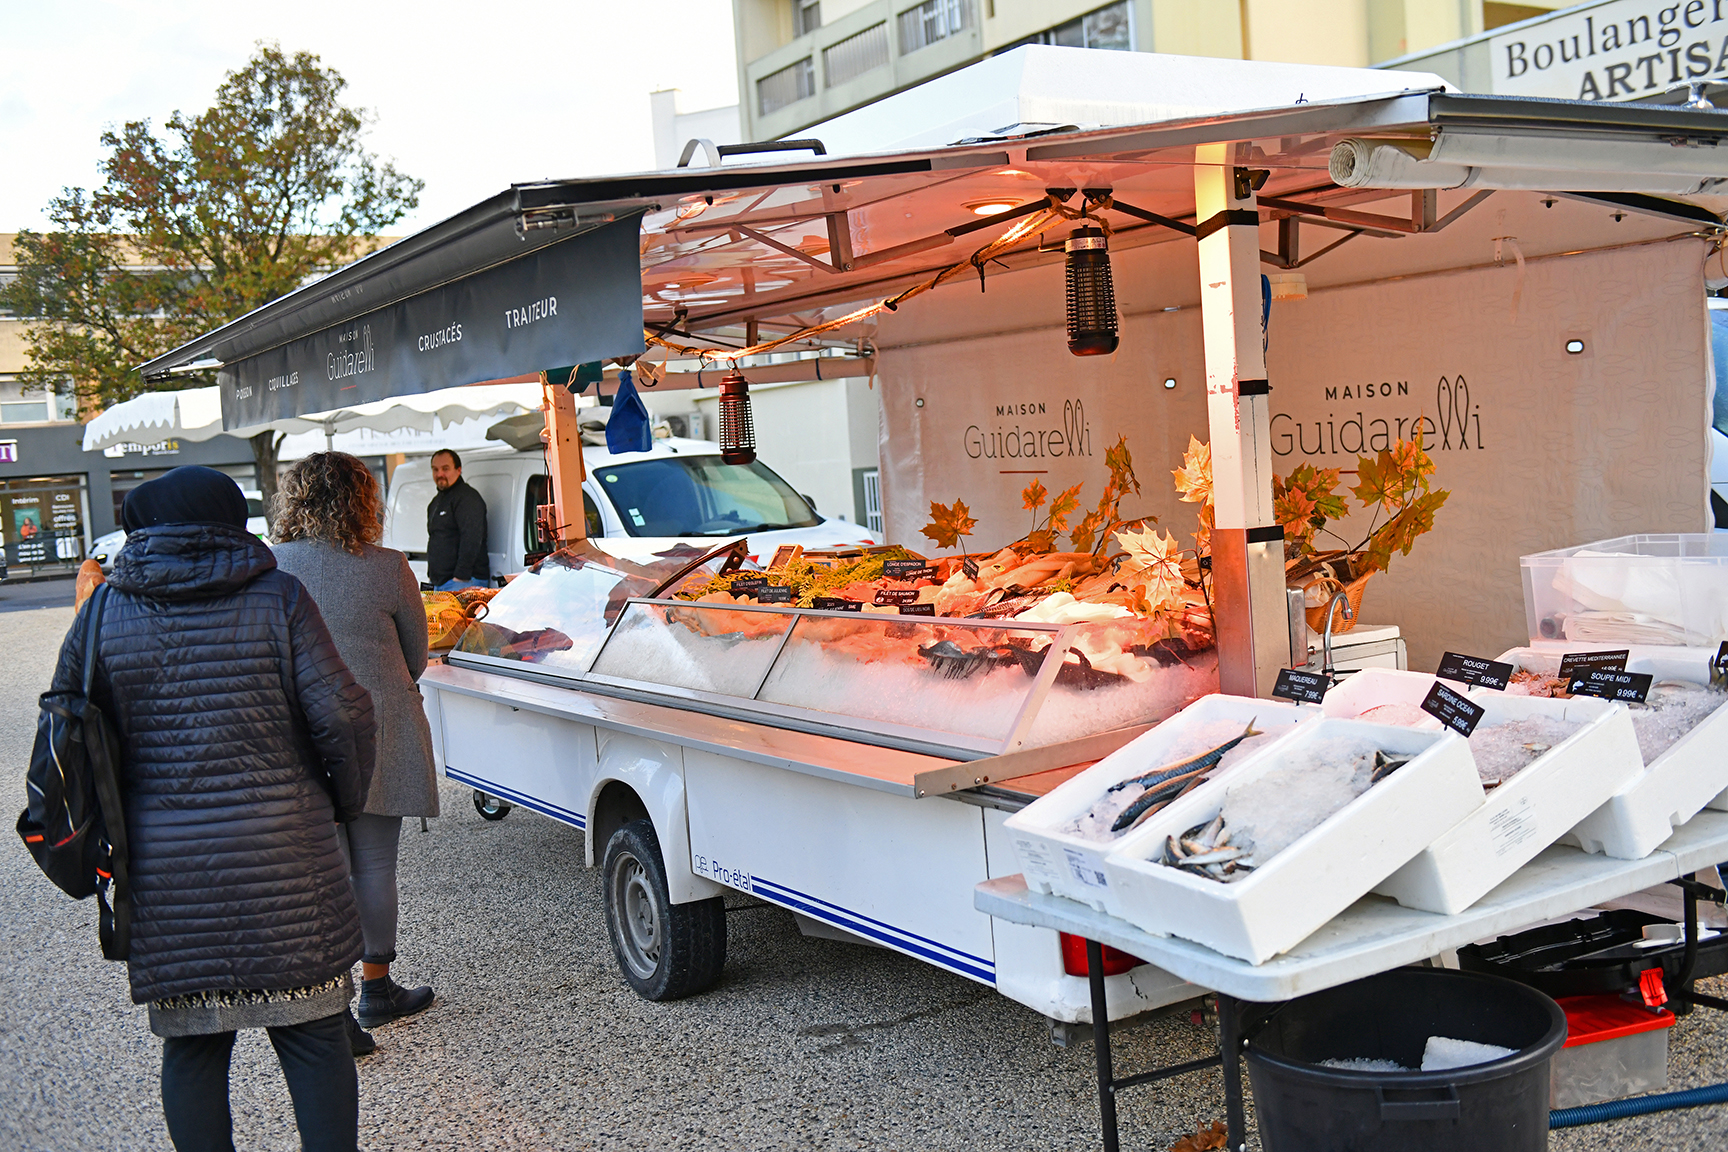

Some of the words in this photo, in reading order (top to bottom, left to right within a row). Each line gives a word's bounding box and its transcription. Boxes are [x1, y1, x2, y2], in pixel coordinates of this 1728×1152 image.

[505, 296, 558, 329] TRAITEUR
[338, 329, 359, 344] MAISON
[418, 321, 463, 352] CRUSTACÉS
[326, 324, 375, 381] Guidarelli
[1325, 381, 1409, 401] MAISON
[996, 402, 1047, 417] MAISON
[1269, 374, 1485, 456] Guidarelli
[963, 398, 1093, 459] Guidarelli
[55, 494, 70, 502] CDI
[53, 514, 77, 523] offres
[1462, 659, 1490, 670] ROUGET
[1563, 656, 1588, 664] CREVETTE
[1288, 674, 1318, 685] MAQUEREAU
[1590, 672, 1616, 682] SOUPE
[1615, 674, 1632, 684] MIDI
[1436, 688, 1459, 706] SARDINE
[1456, 700, 1475, 716] OCEAN
